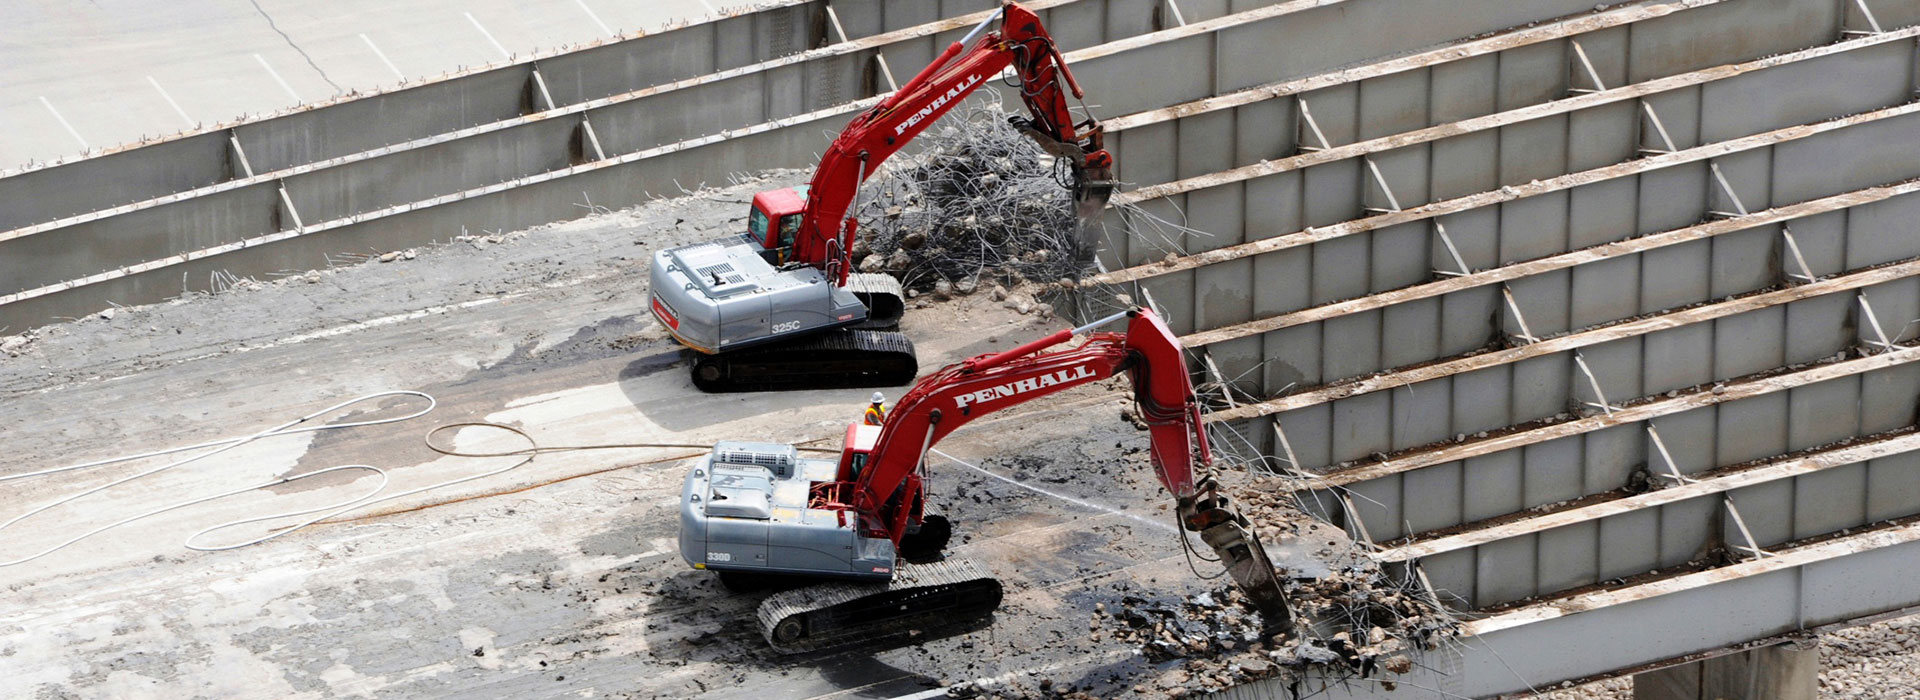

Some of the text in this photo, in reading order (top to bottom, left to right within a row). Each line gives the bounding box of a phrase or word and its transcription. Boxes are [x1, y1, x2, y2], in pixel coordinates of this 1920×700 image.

[894, 74, 982, 135] PENHALL
[772, 320, 800, 334] 325C
[953, 365, 1096, 408] PENHALL
